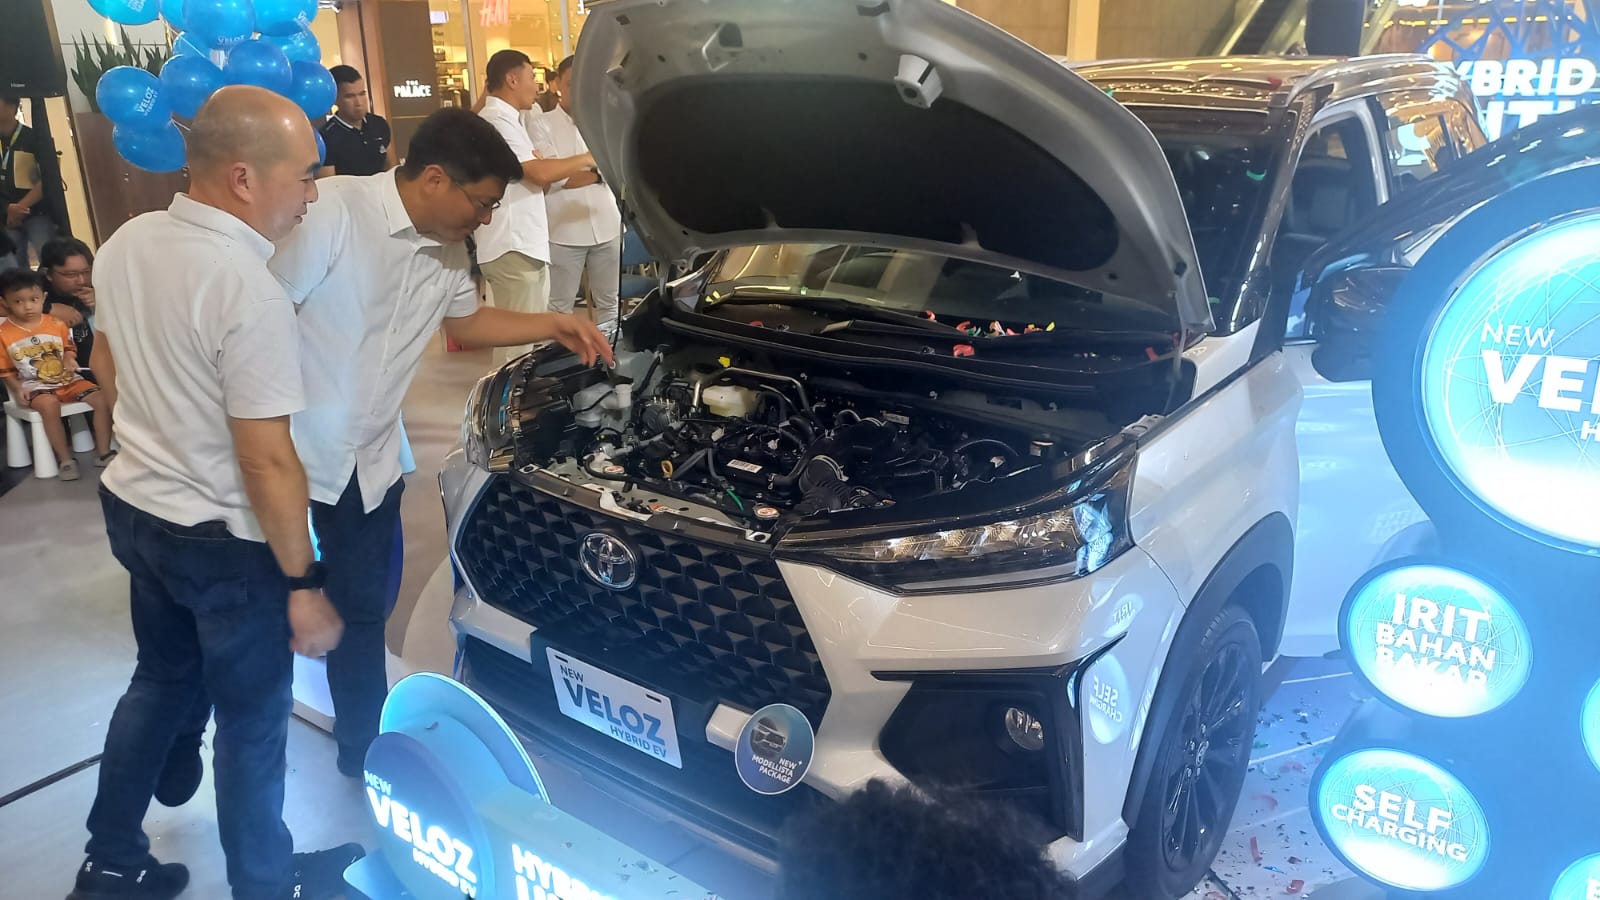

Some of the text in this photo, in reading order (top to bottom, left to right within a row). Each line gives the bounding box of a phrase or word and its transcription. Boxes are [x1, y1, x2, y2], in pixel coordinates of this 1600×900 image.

[393, 85, 432, 98] PALACE
[1456, 59, 1597, 96] YBRID
[136, 86, 154, 113] VELOZ
[1481, 322, 1555, 348] NEW
[1391, 592, 1492, 643] IRIT
[1375, 621, 1496, 670] BAHAN
[560, 664, 584, 682] NEW
[563, 678, 665, 745] VELOZ
[610, 724, 667, 759] HYBRID EV
[751, 754, 793, 777] MODELLISTA
[759, 765, 793, 785] PACKAGE
[779, 758, 798, 770] NEW
[364, 770, 391, 796] NEW
[1352, 784, 1453, 834] SELF
[366, 786, 477, 884] VELOZ
[1331, 803, 1468, 861] CHARGING
